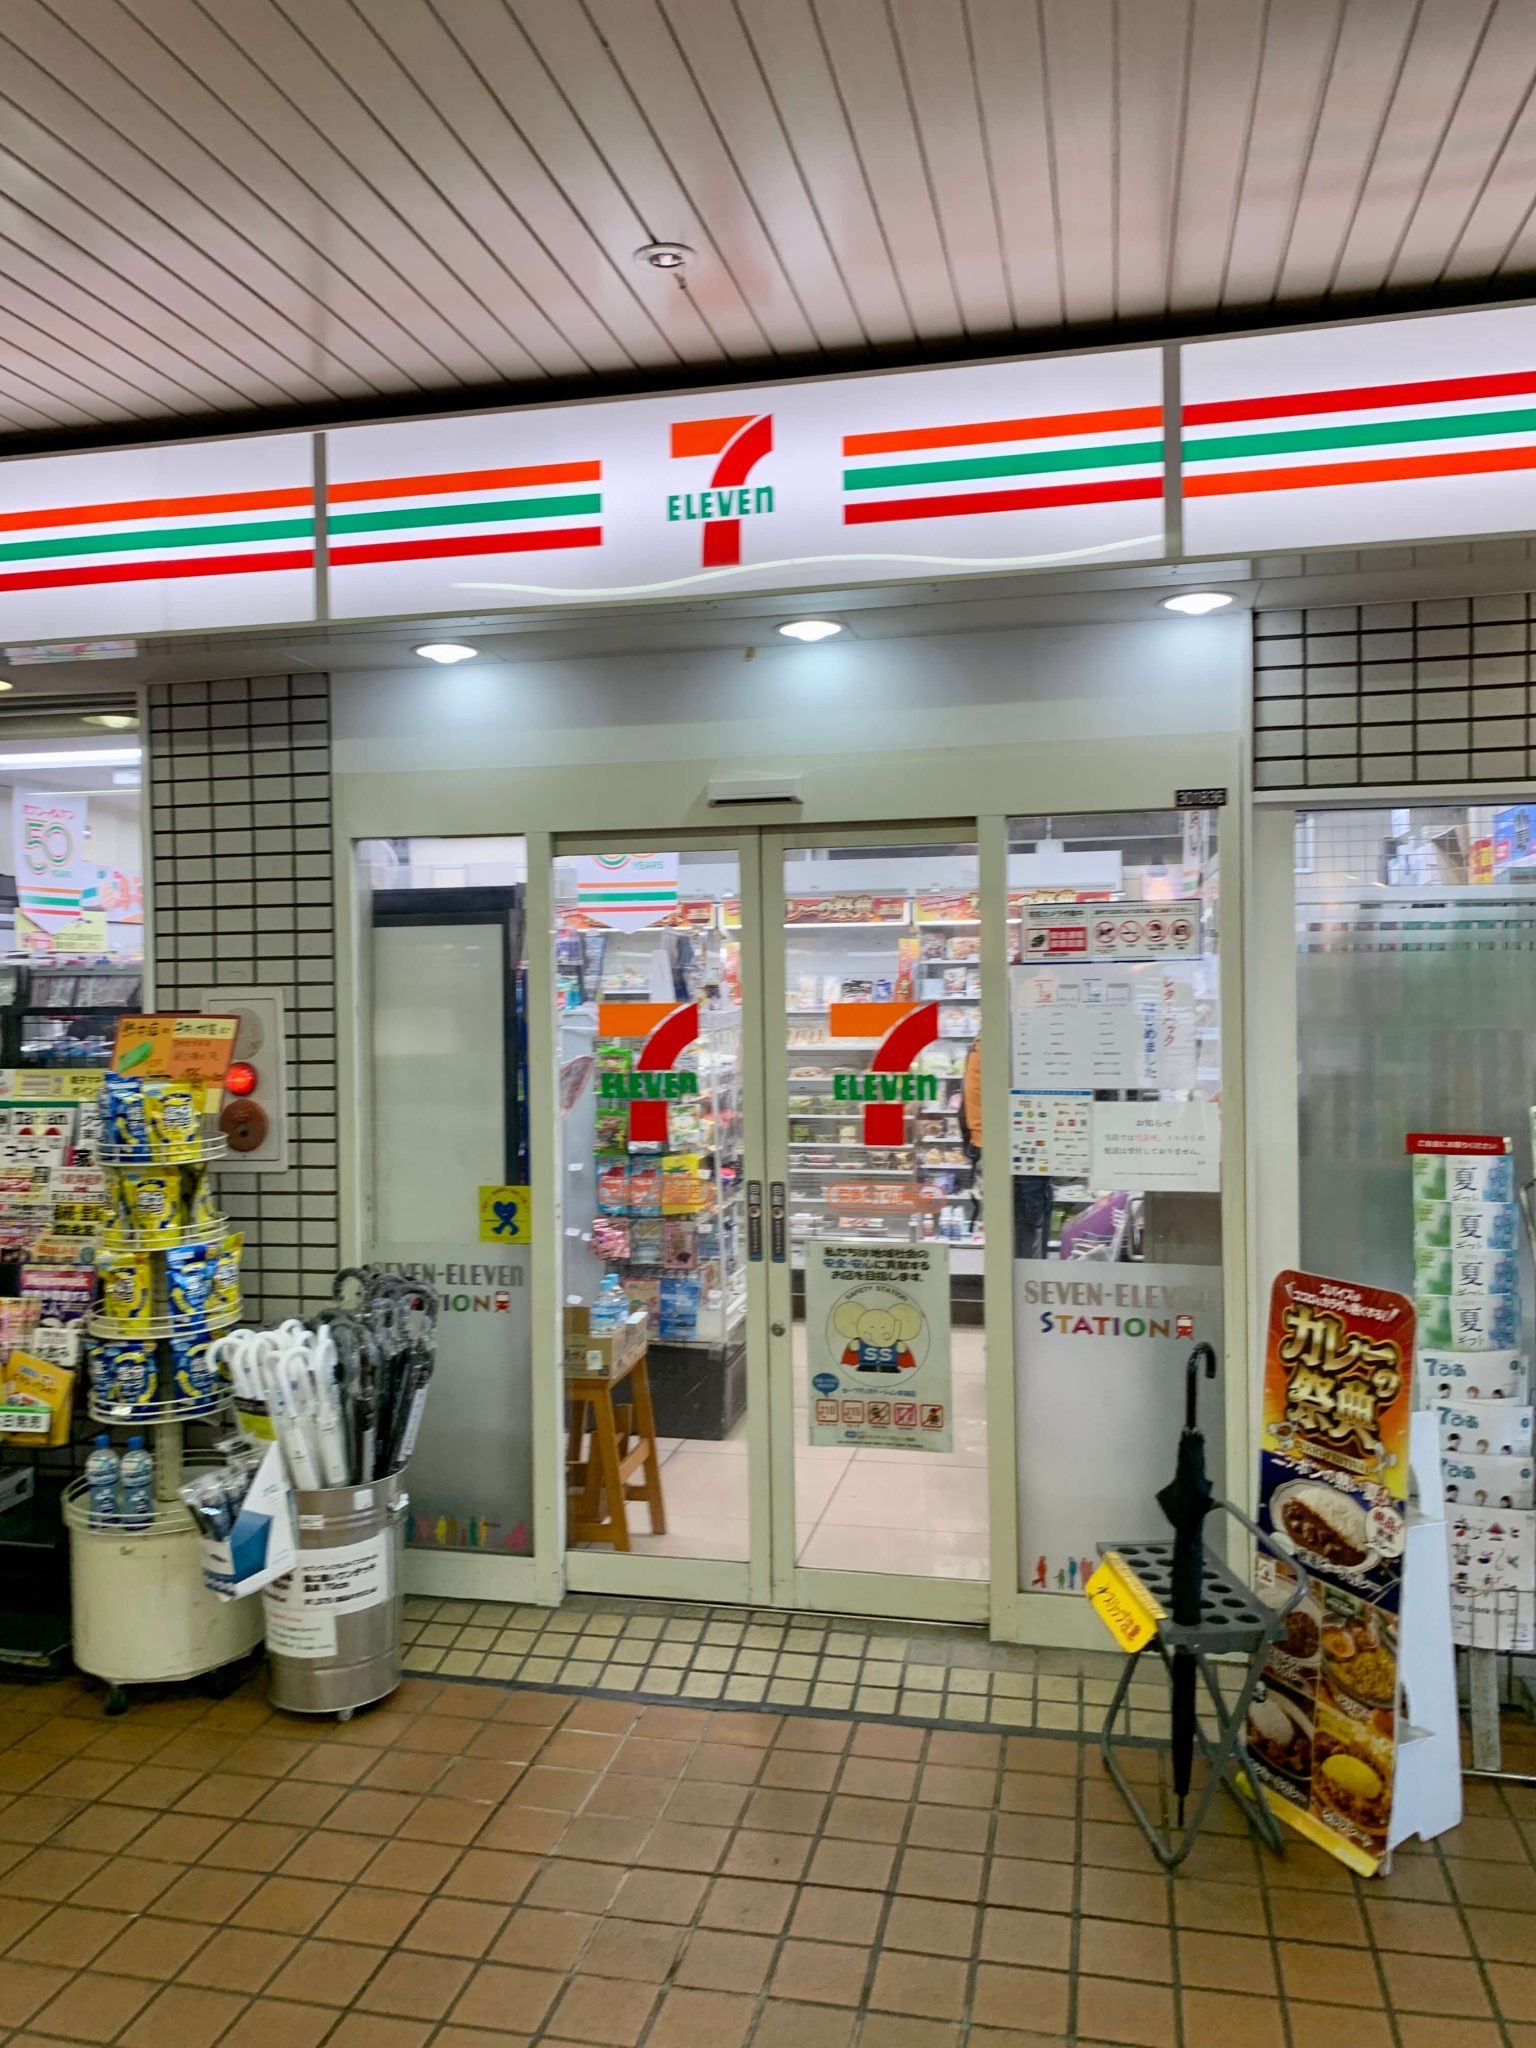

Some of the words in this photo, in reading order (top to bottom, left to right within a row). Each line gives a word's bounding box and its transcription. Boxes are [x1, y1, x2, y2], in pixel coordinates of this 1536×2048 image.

[670, 415, 773, 566] 7
[24, 818, 73, 876] 50
[597, 1002, 698, 1142] 7
[829, 1002, 938, 1145] 7
[15, 1112, 68, 1125] Taran
[5, 1144, 50, 1158] コーヒー
[1452, 1167, 1478, 1191] 夏
[1456, 1214, 1483, 1239] 夏
[1457, 1261, 1483, 1286] 夏
[1040, 1311, 1170, 1338] STATION
[1456, 1307, 1483, 1333] 夏
